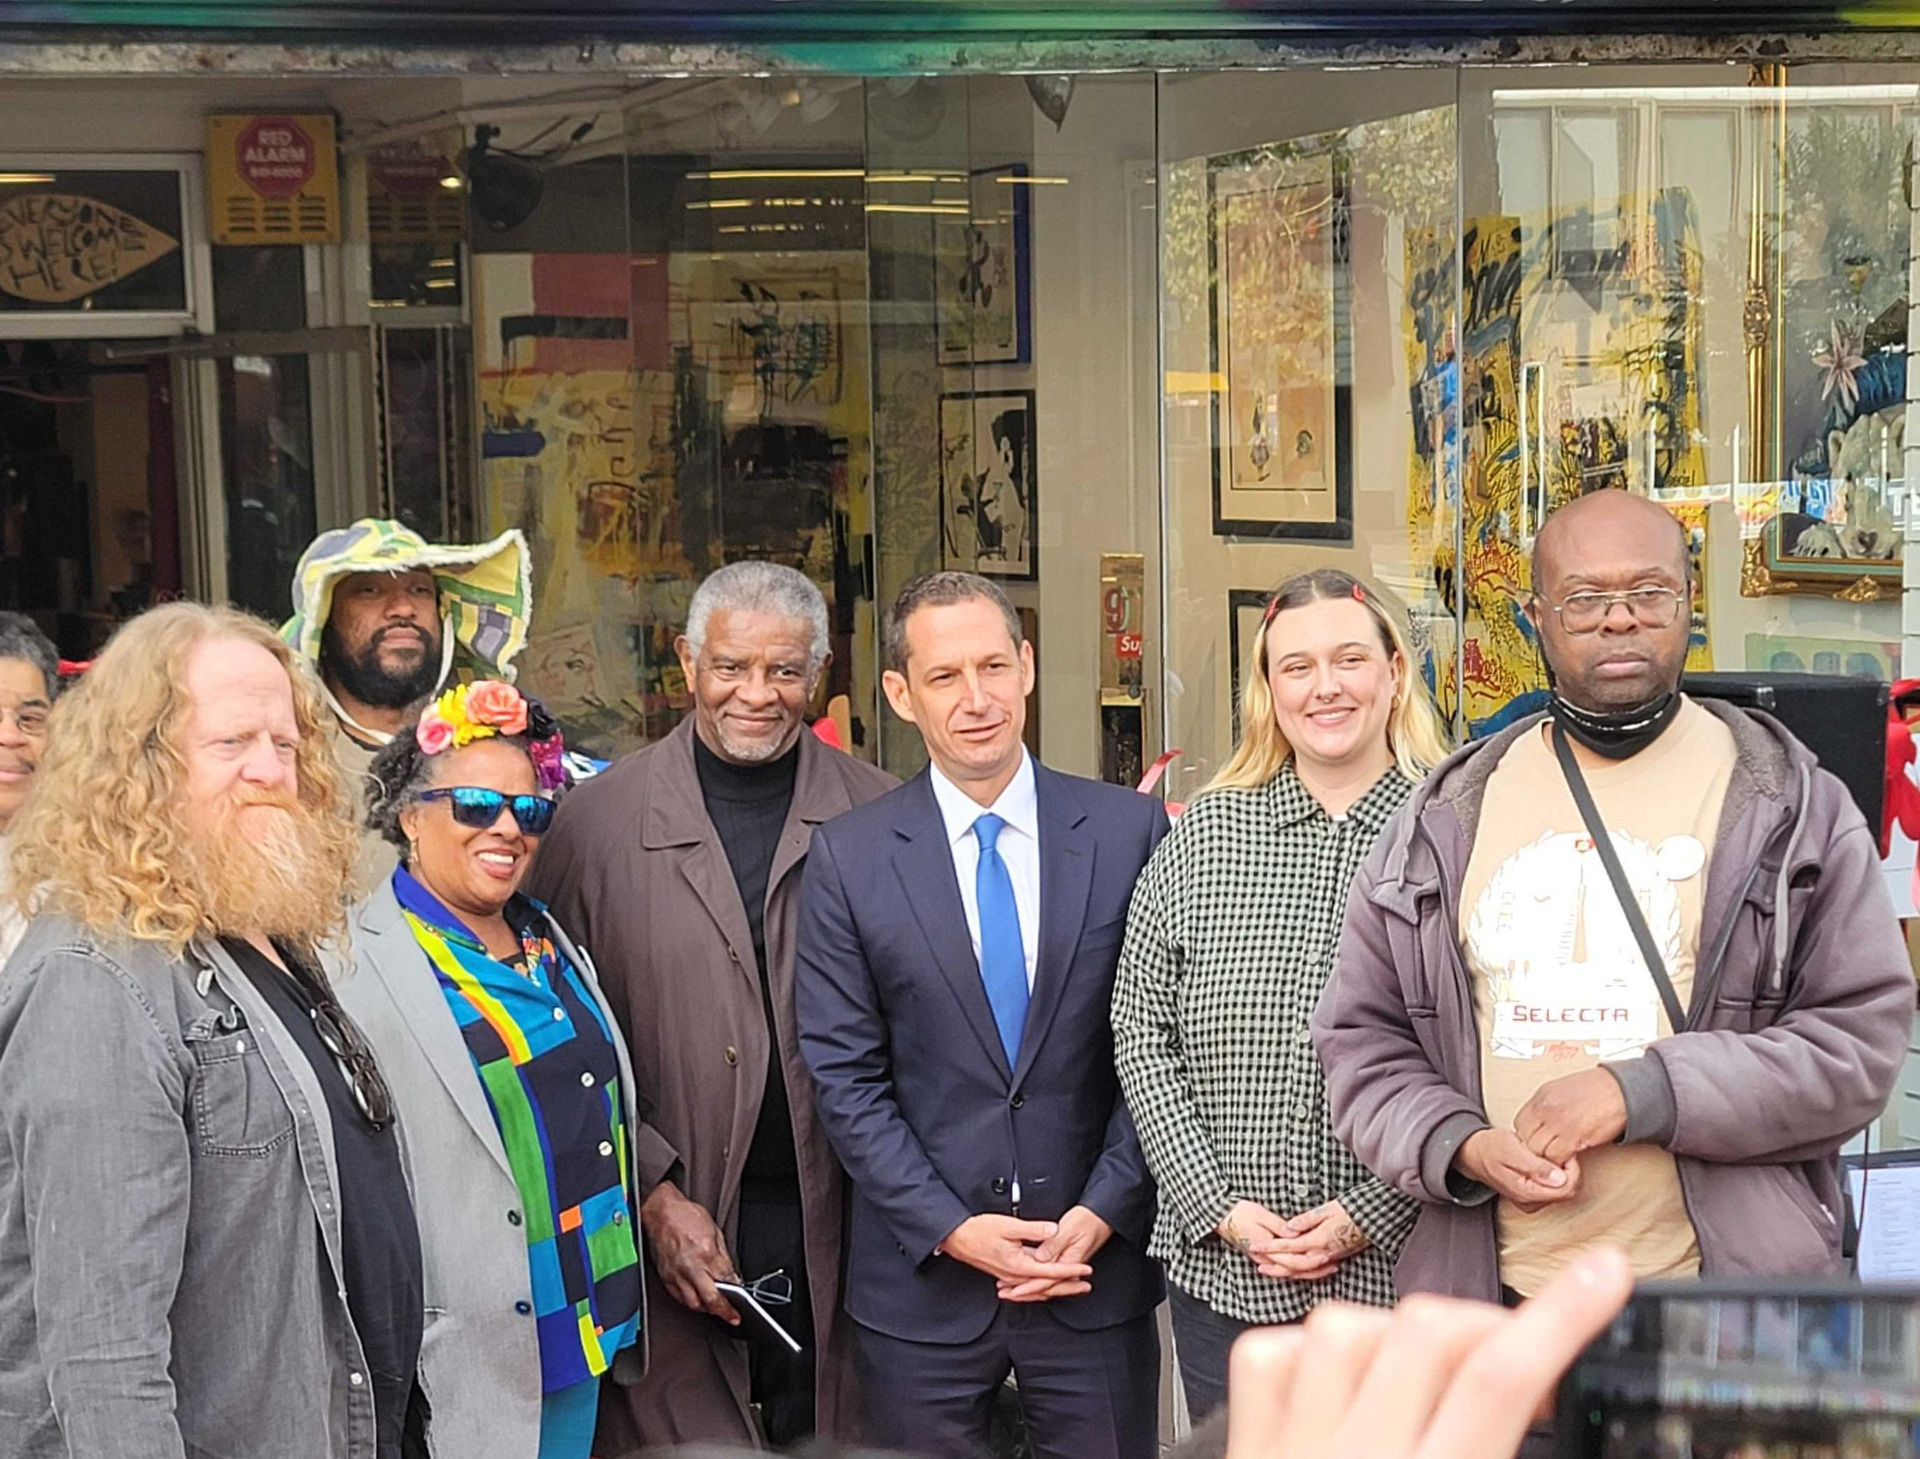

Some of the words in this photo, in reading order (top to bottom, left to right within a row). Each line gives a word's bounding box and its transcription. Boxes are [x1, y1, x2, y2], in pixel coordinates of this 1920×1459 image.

[258, 130, 293, 147] RED
[244, 146, 306, 163] ALARM
[16, 223, 147, 260] WELCOME
[1511, 1004, 1630, 1023] SELECTA
